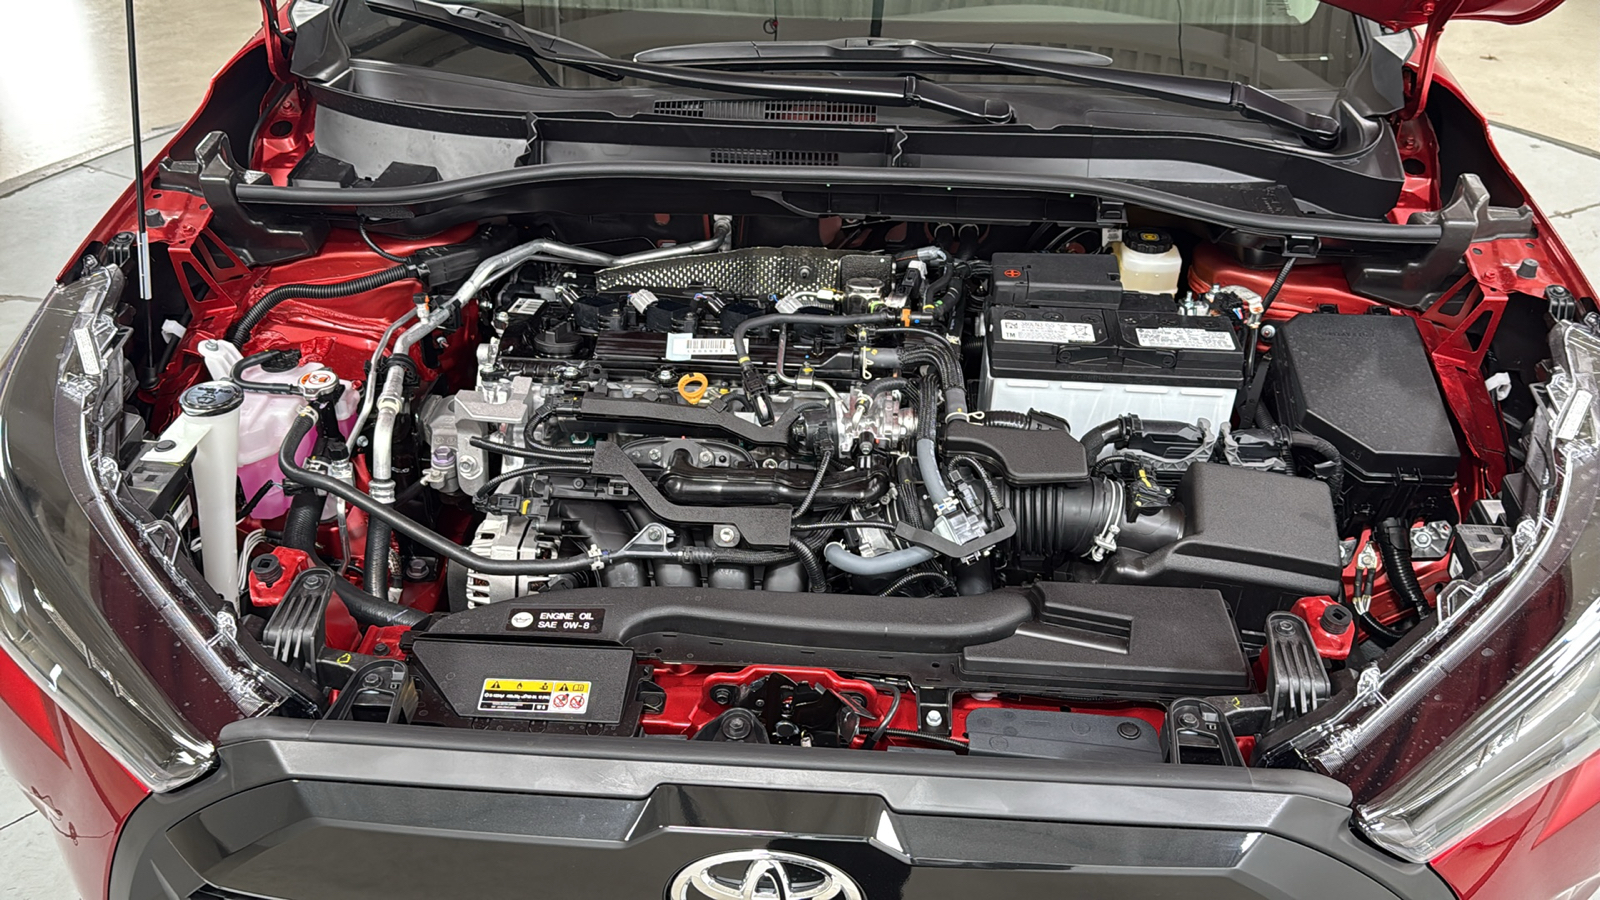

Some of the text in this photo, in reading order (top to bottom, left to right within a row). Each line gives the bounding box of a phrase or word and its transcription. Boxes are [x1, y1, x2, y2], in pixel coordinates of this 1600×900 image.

[540, 612, 594, 620] ENGINE OIL
[563, 621, 590, 629] 0W-8
